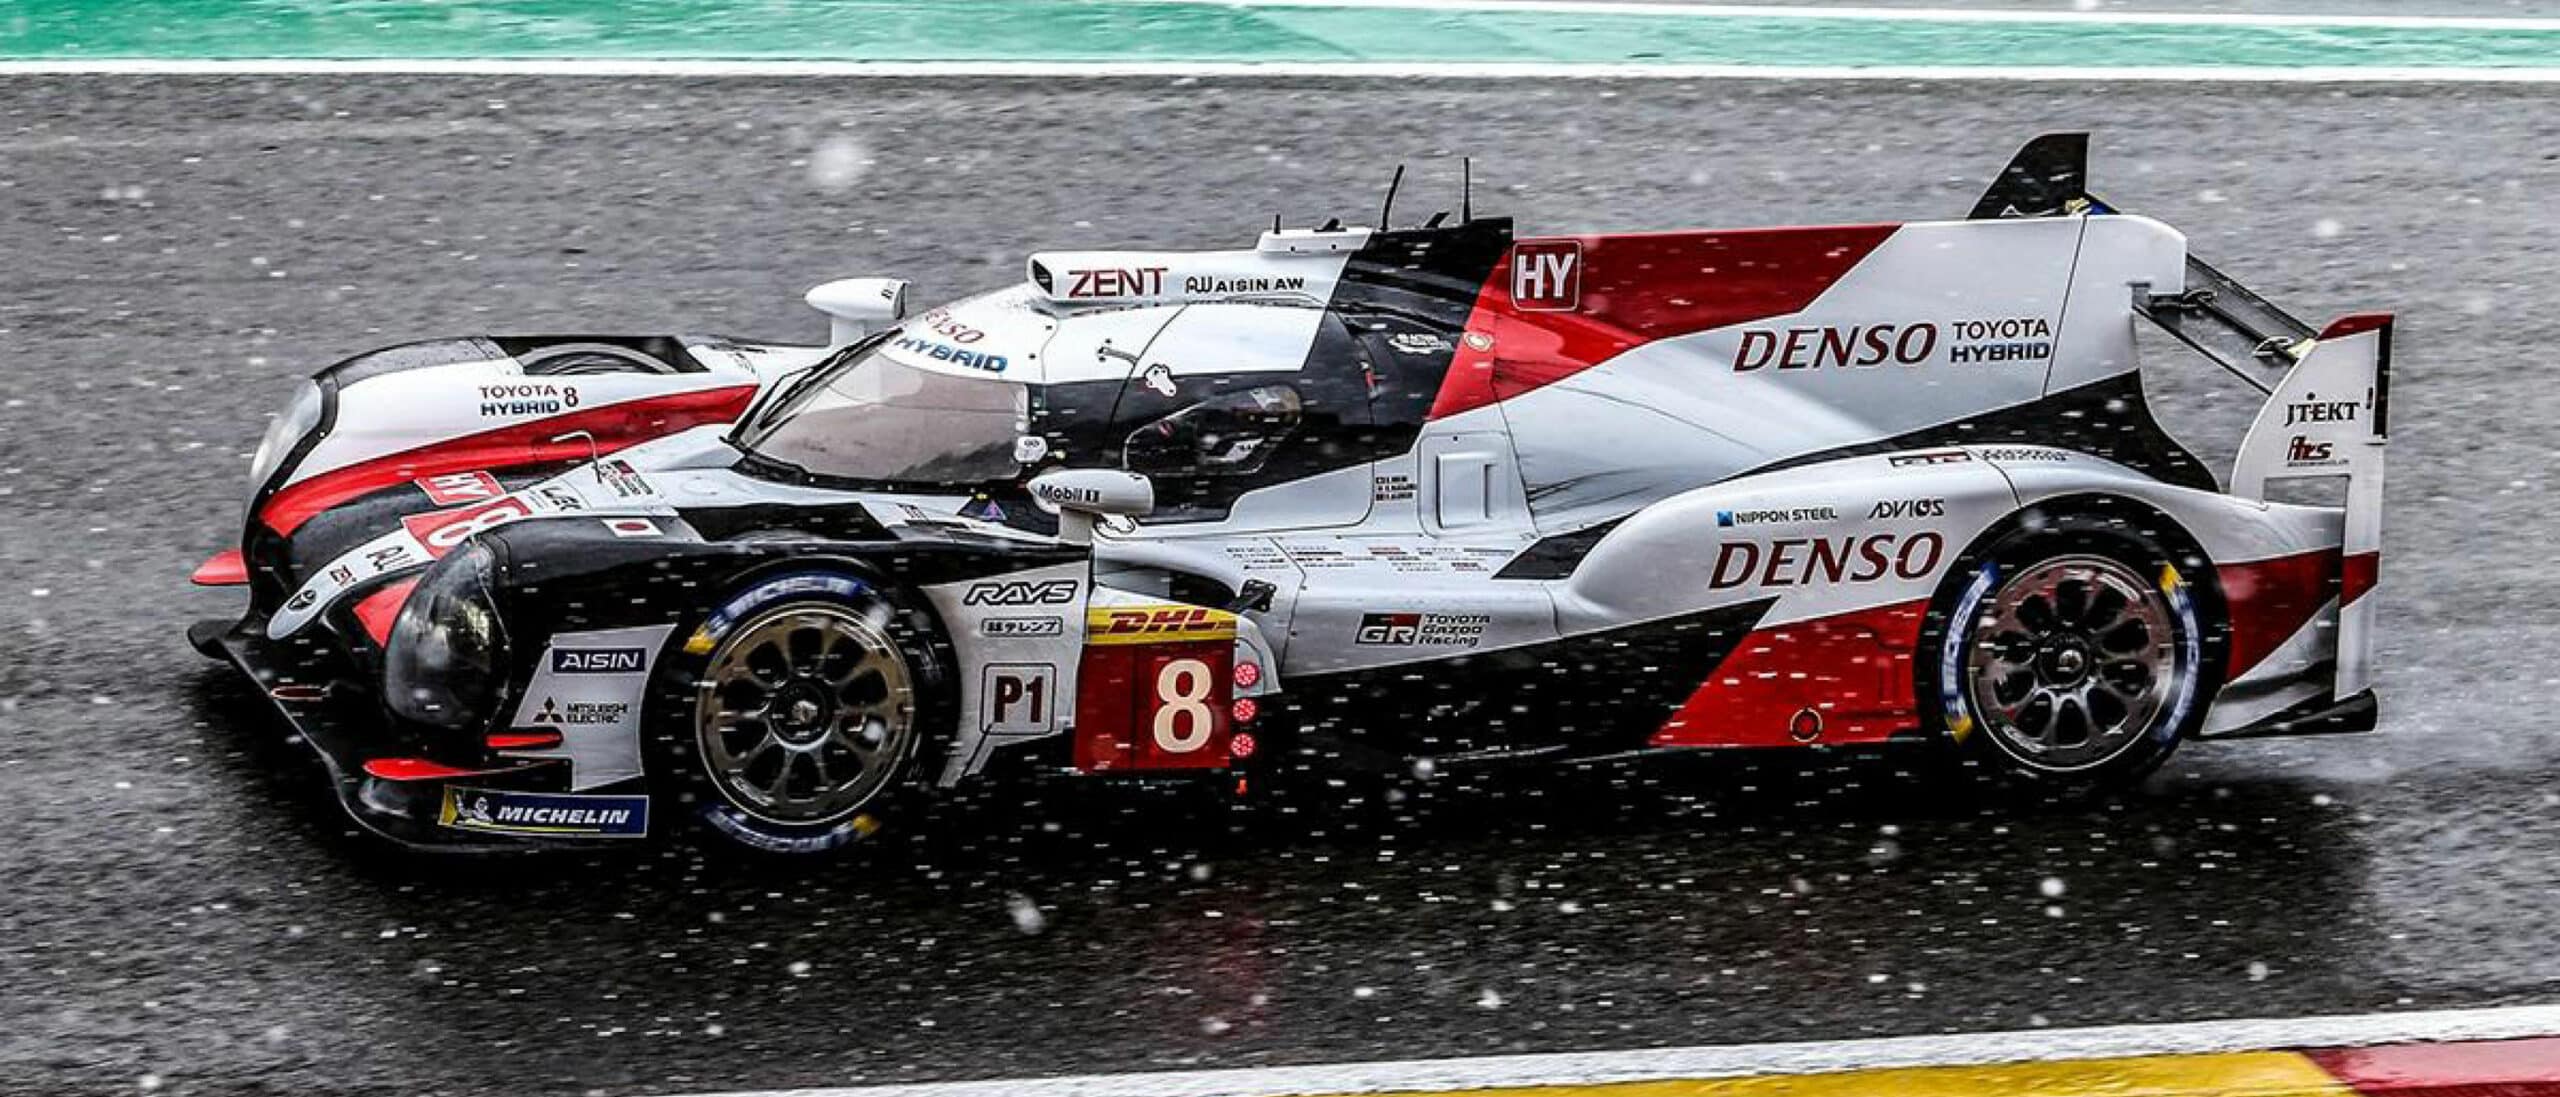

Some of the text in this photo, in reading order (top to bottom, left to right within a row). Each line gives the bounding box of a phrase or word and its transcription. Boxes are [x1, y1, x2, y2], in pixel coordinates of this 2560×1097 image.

[1068, 268, 1168, 298] ZENT
[1214, 278, 1269, 293] AISIN
[1275, 278, 1305, 291] AW
[1516, 253, 1576, 299] HY
[1952, 319, 2050, 341] TOYOTA
[894, 338, 1008, 373] HYBRID
[1733, 322, 1938, 372] DENSO
[1950, 342, 2050, 363] HYBRID
[478, 385, 579, 408] TOYOTA 8
[480, 400, 560, 416] HYBRID
[2284, 402, 2360, 427] JTEKT
[1040, 483, 1083, 503] Mobil
[1736, 507, 1838, 524] NIPPON STEEL
[1708, 532, 1944, 590] DENSO
[963, 580, 1079, 606] RAYS
[1107, 609, 1216, 634] DHL
[1424, 613, 1490, 624] TOYOTA
[1358, 625, 1416, 645] GR
[560, 652, 639, 668] AISIN
[993, 675, 1044, 723] P1
[1153, 658, 1213, 754] 8
[496, 805, 631, 824] MICHELIN
